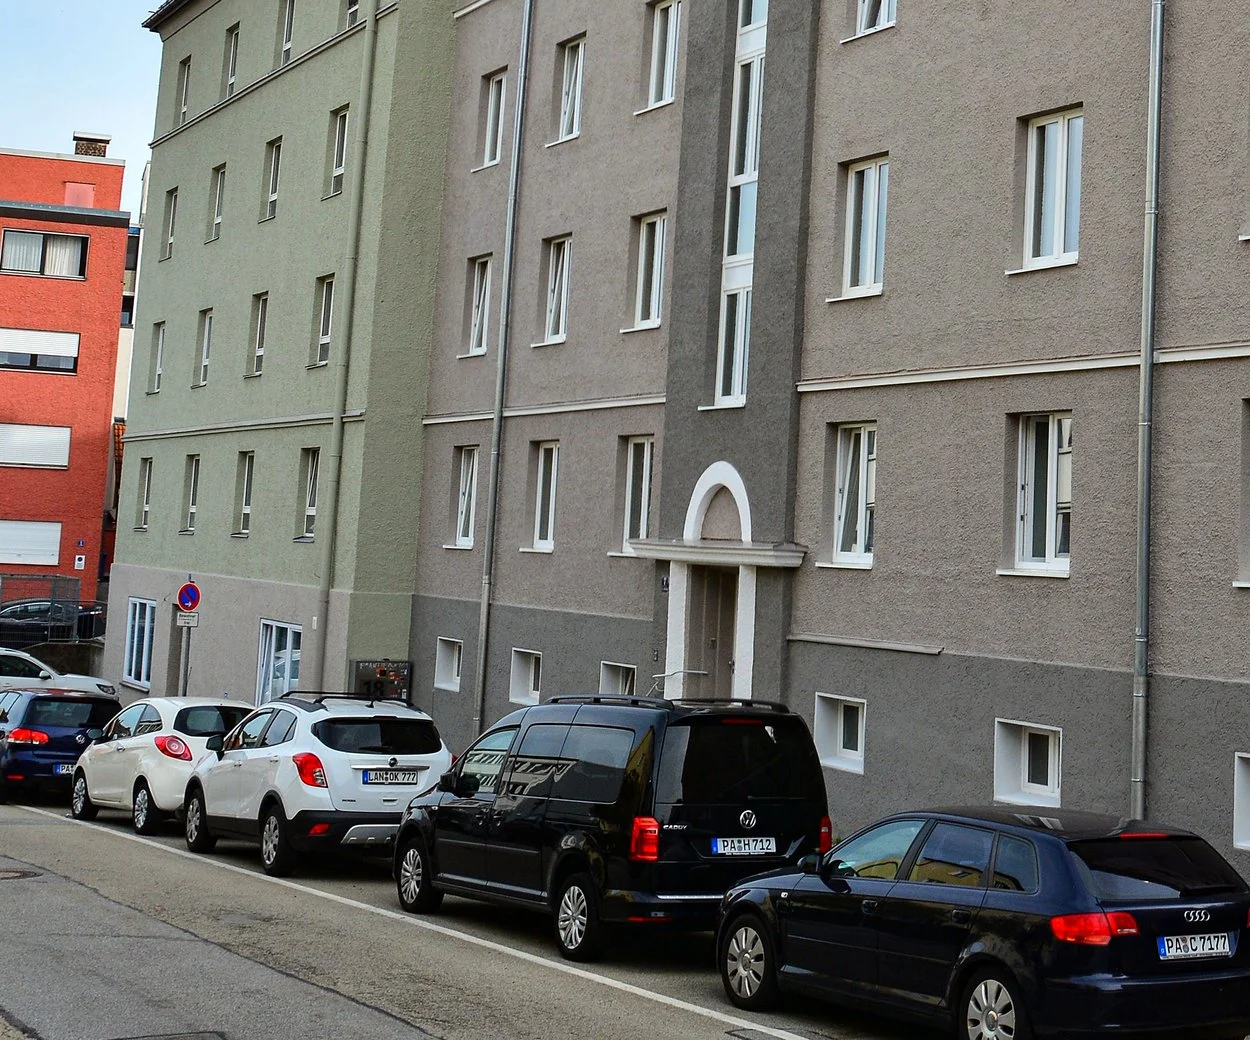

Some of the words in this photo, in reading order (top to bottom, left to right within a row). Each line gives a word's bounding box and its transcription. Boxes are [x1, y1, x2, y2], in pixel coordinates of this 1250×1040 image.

[368, 772, 384, 781] LAN
[389, 772, 400, 781] OK
[401, 772, 416, 781] 777
[721, 839, 737, 852] PA
[743, 839, 751, 851] H
[752, 839, 772, 850] 712
[1166, 937, 1183, 953] PA
[1189, 936, 1198, 951] C
[1199, 934, 1227, 951] 7177
